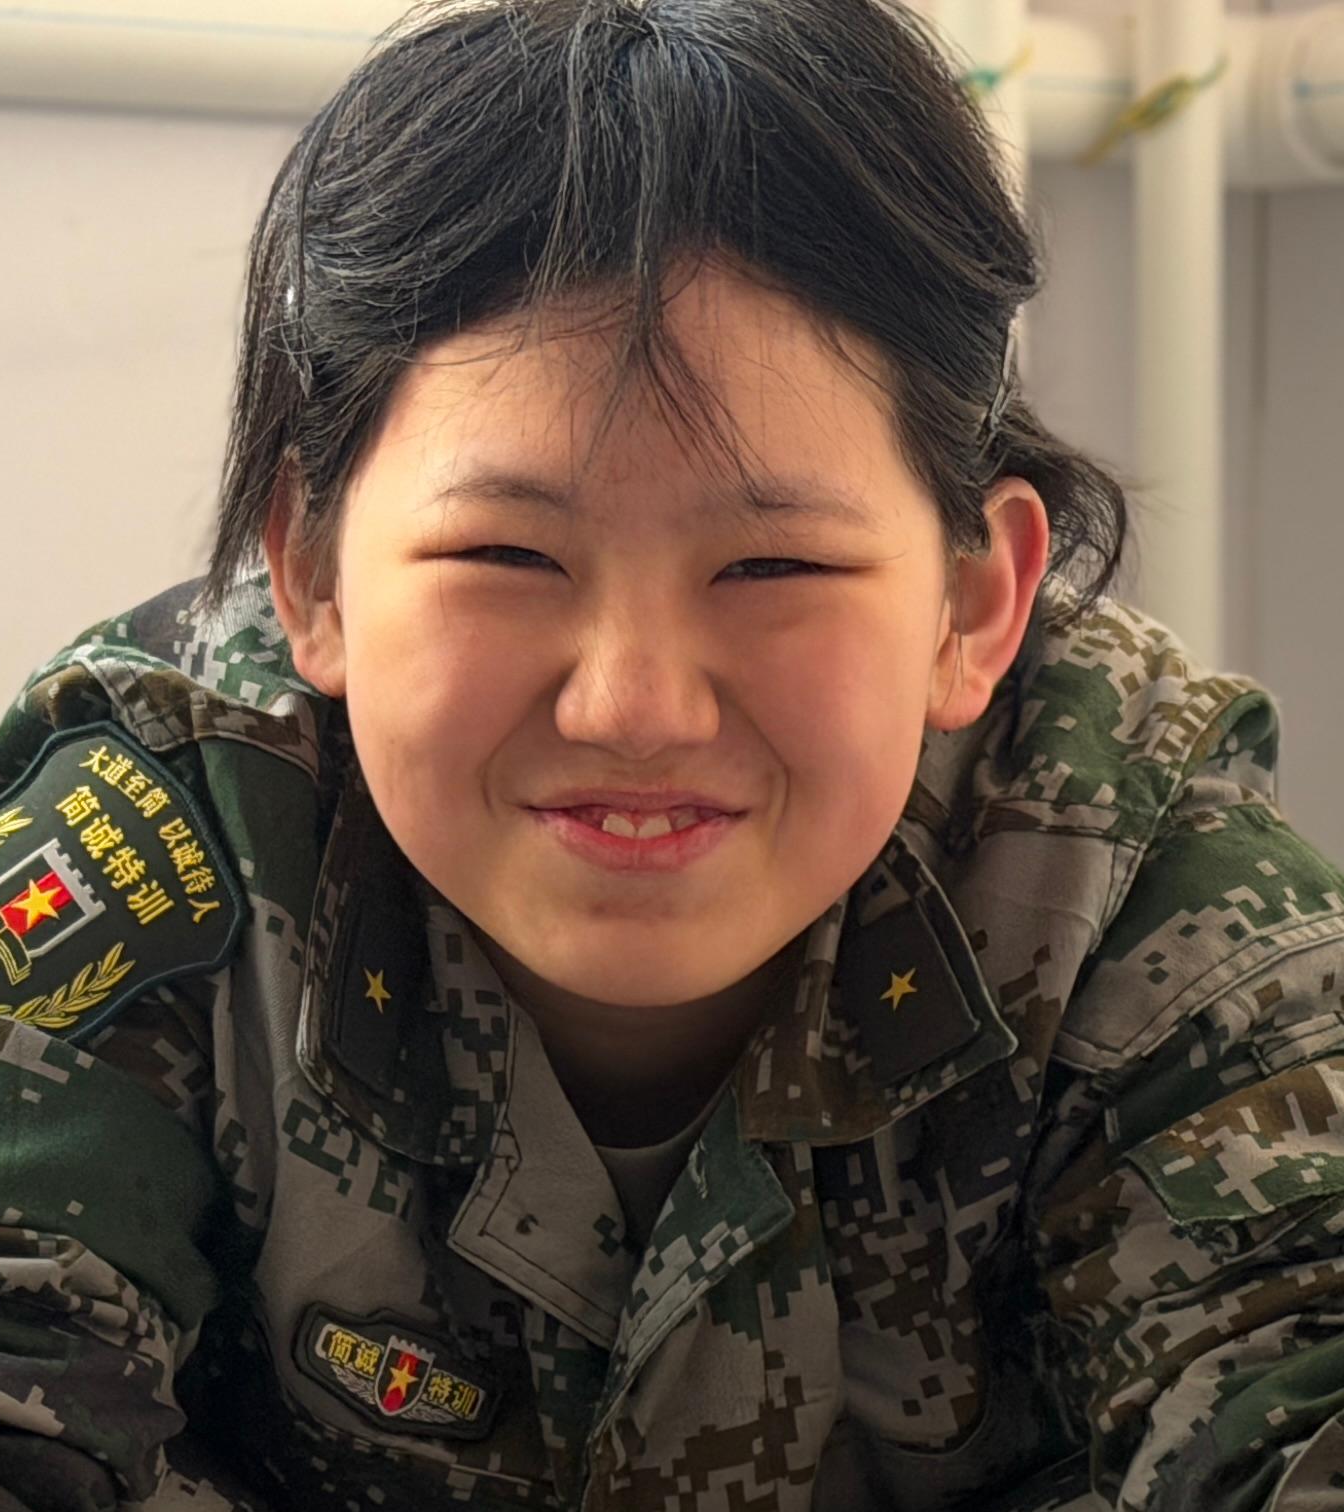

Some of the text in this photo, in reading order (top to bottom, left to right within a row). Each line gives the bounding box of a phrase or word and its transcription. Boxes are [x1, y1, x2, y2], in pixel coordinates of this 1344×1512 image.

[55, 785, 175, 926] 简诚特训
[78, 745, 221, 924] 大道至简 以诚待人
[427, 1373, 480, 1416] 特训
